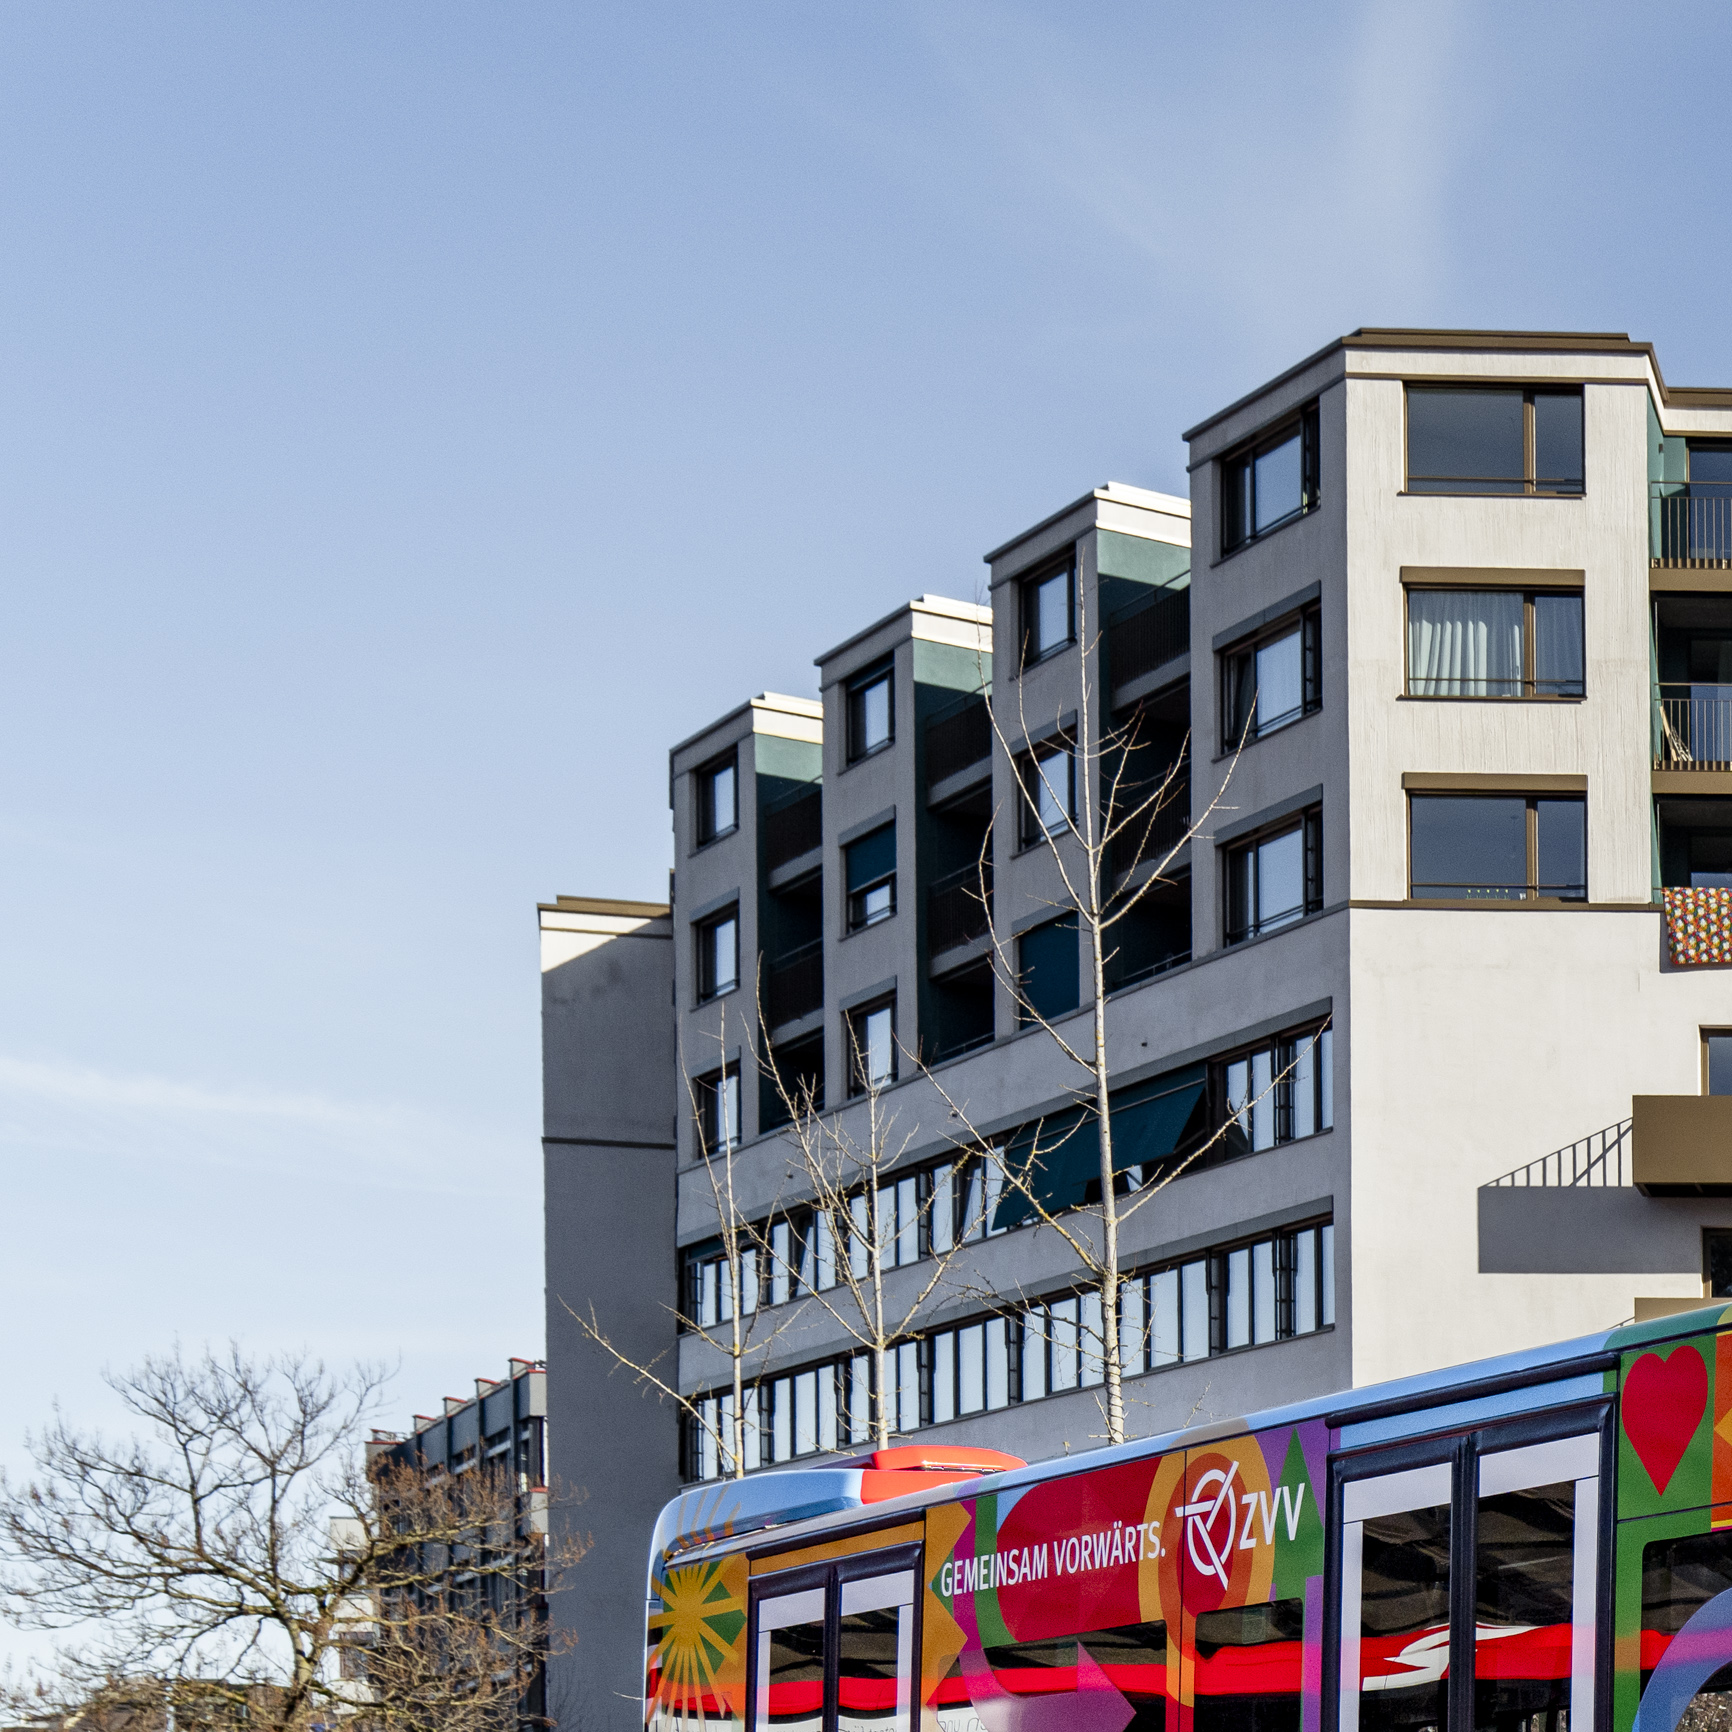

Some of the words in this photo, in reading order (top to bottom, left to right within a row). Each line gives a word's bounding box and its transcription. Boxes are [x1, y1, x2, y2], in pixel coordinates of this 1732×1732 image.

[1239, 1482, 1306, 1551] ZVV
[940, 1543, 1049, 1598] GEMEINSAM
[1053, 1520, 1166, 1576] VORWÄRTS.
